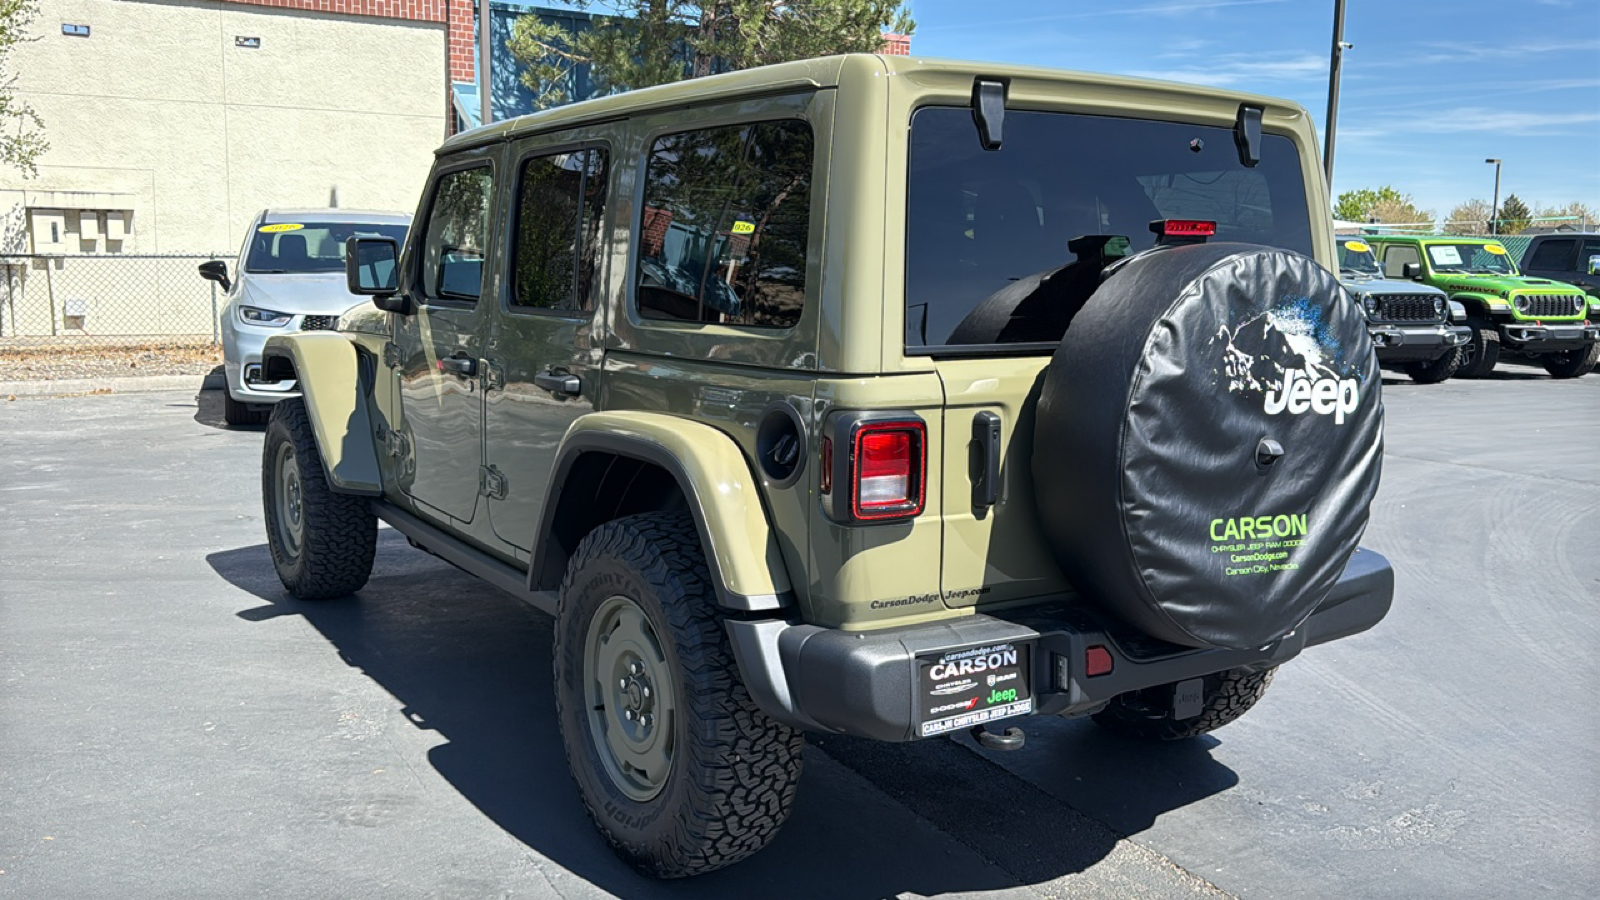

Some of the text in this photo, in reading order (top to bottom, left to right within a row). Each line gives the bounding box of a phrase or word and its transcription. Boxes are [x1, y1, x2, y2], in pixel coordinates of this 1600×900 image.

[1264, 368, 1359, 425] Jeep
[1210, 513, 1307, 541] CARSON
[1265, 540, 1282, 549] RAM
[929, 650, 1017, 680] CARSON
[987, 688, 1017, 704] Jeep
